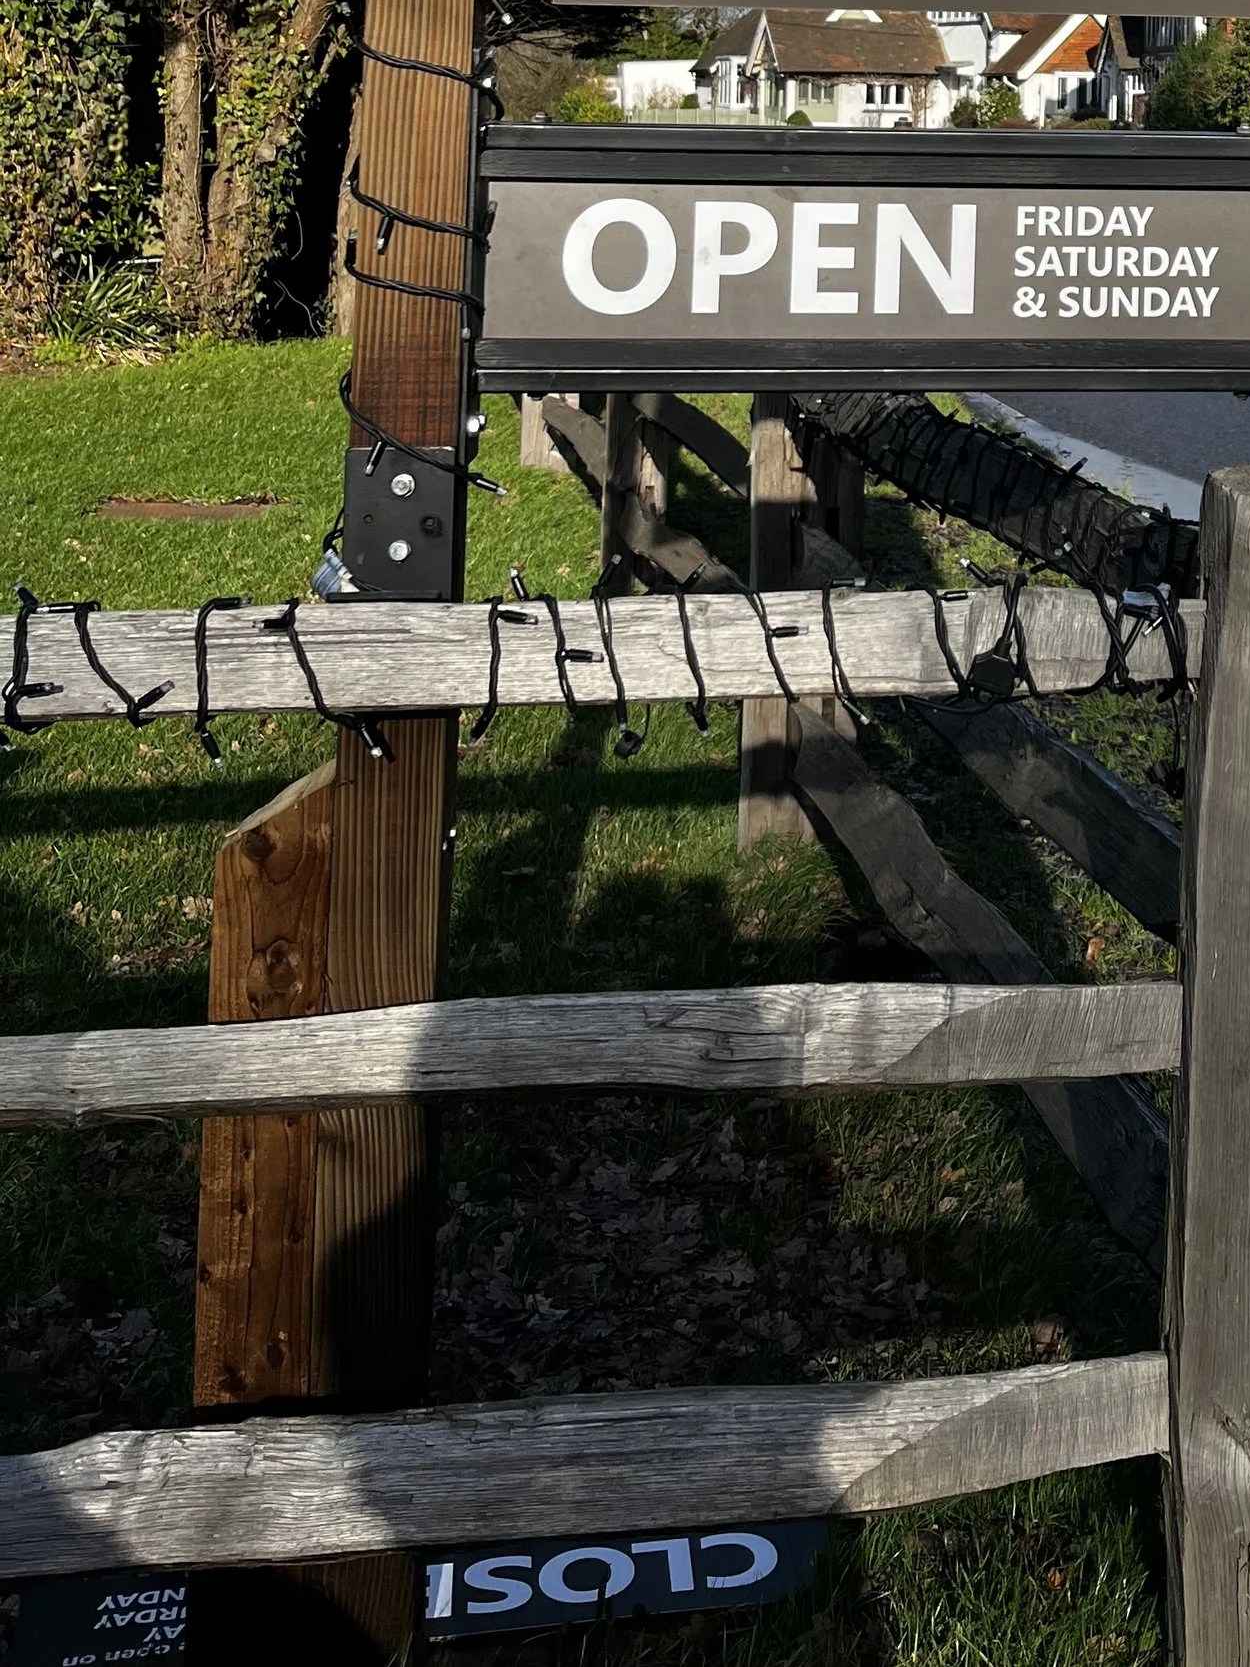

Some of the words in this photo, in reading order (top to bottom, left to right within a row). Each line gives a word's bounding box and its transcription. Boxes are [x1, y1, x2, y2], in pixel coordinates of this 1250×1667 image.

[1015, 205, 1155, 237] FRIDAY
[560, 197, 978, 316] OPEN
[1013, 245, 1220, 278] SATURDAY
[1012, 286, 1048, 319] &
[1057, 286, 1220, 319] SUNDAY
[424, 1532, 779, 1619] CLOS
[96, 1586, 187, 1611] NDAY
[92, 1605, 188, 1630] RDAY
[61, 1653, 97, 1667] on
